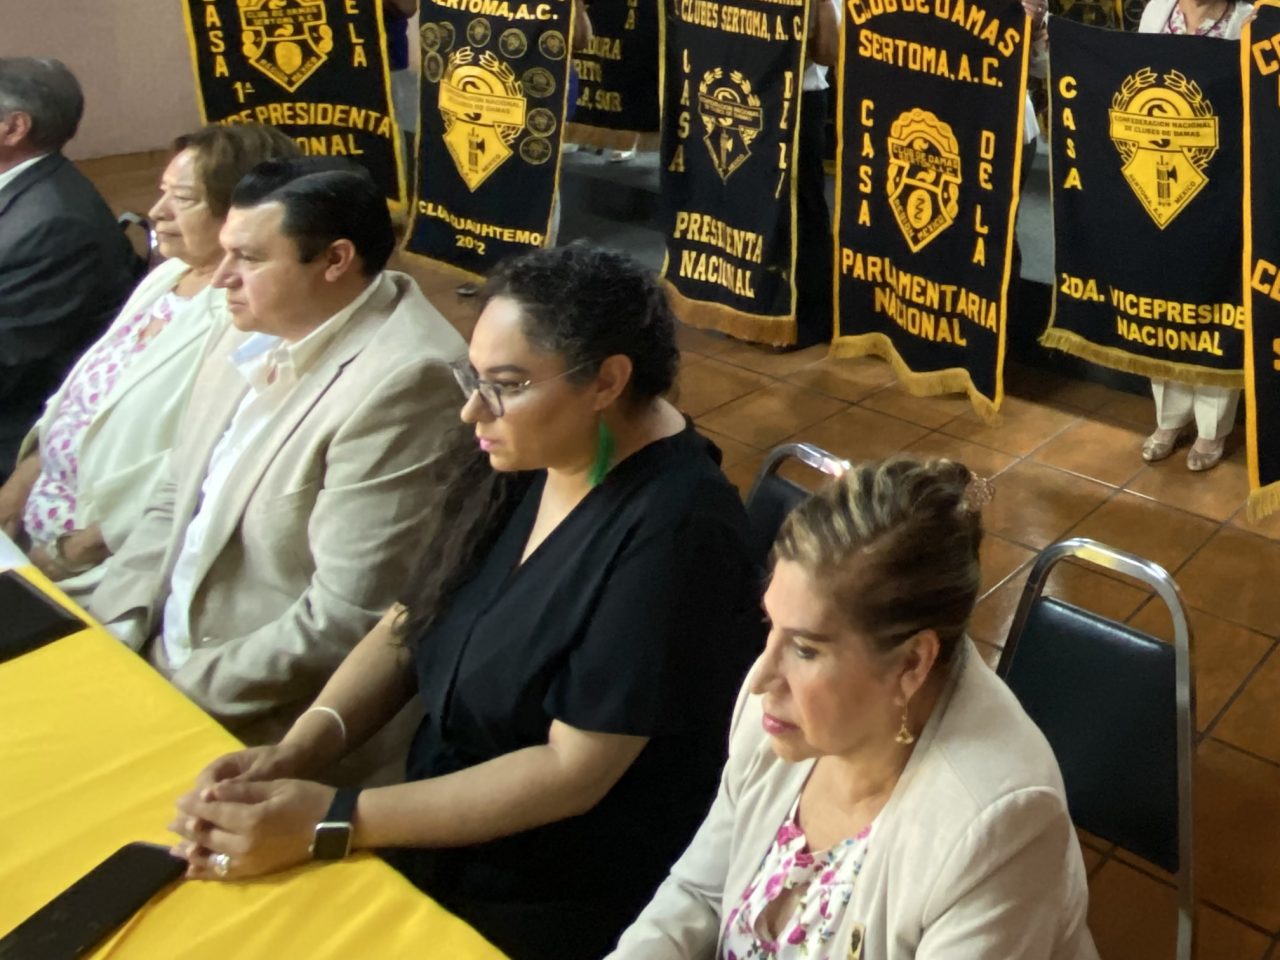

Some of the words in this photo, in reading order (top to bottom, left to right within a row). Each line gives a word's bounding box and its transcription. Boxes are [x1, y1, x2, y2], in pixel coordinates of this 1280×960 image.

[1058, 76, 1083, 190] CASA
[1114, 115, 1170, 128] CONFEDERACION
[1172, 121, 1213, 129] NACIONAL
[858, 99, 875, 227] CASA
[1174, 180, 1196, 205] MEXICO
[1060, 273, 1105, 302] 2DA.
[1117, 316, 1223, 356] NACIONAL
